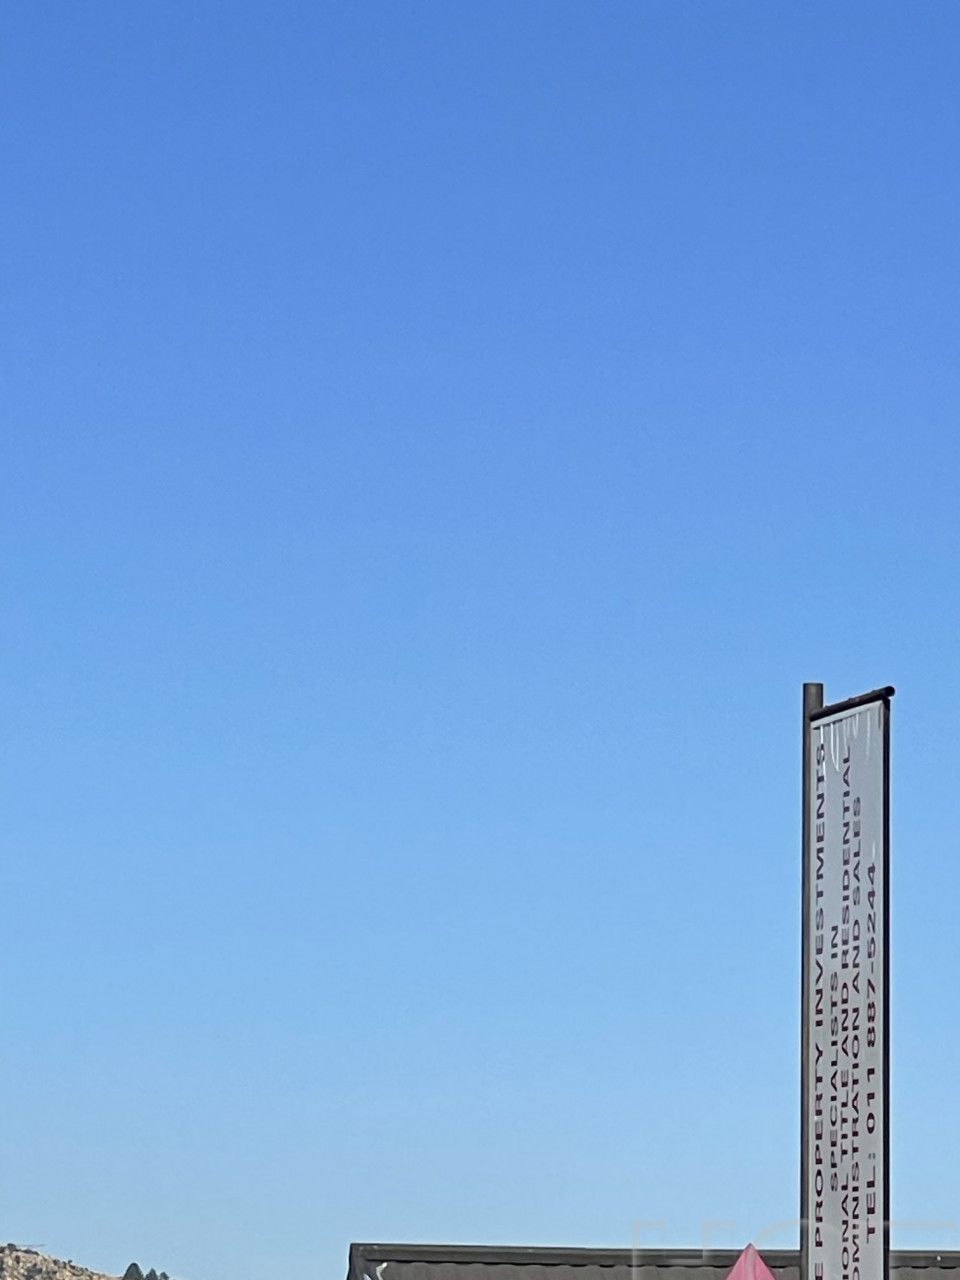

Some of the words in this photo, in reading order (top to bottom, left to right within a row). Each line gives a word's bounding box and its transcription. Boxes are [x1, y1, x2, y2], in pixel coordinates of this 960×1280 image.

[815, 743, 826, 1028] INVESTMENTS
[841, 746, 851, 970] RESIDENTIAL
[852, 796, 862, 906] SALES
[830, 925, 839, 959] IN
[852, 919, 861, 994] AND
[866, 862, 877, 1048] 887-5244
[841, 982, 849, 1057] AND
[829, 972, 839, 1193] SPECIALISTS
[840, 1069, 849, 1164] TITLE
[866, 1067, 876, 1134] 011
[814, 1043, 824, 1248] PROPERTY
